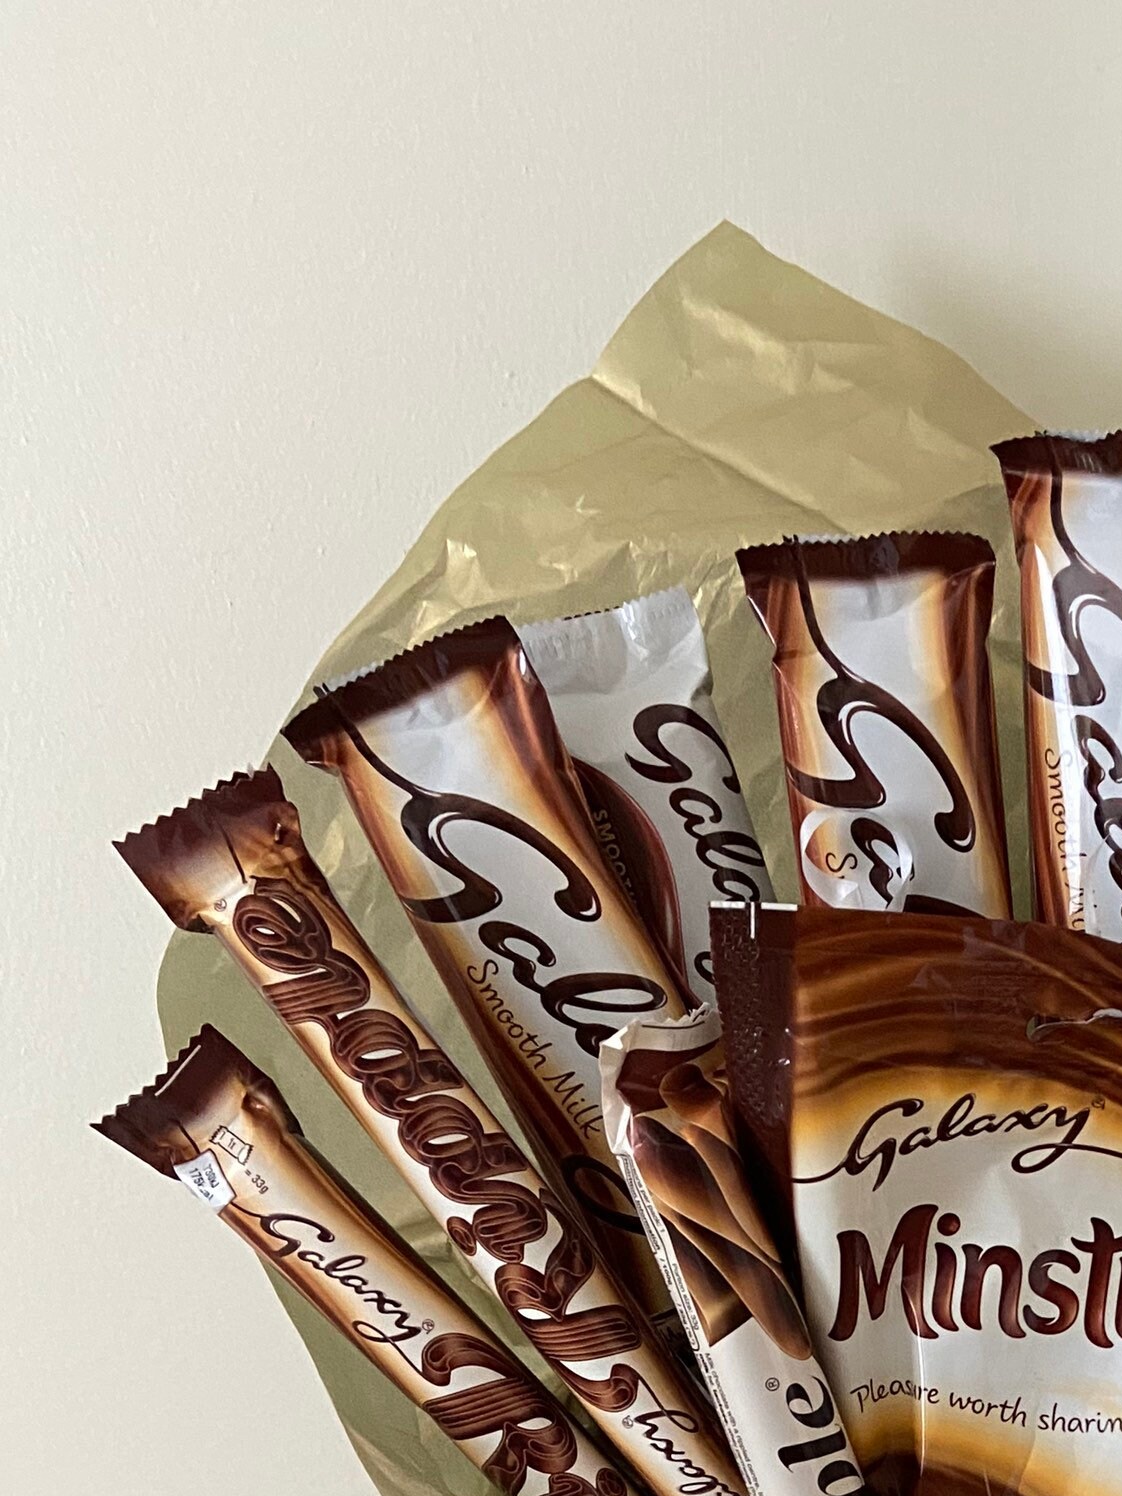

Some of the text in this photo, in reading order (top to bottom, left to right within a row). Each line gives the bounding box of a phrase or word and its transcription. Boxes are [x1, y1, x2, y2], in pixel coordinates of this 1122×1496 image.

[467, 959, 603, 1140] Smooth Milk
[233, 876, 641, 1412] Ripple
[251, 1174, 269, 1195] 33g
[838, 1093, 1092, 1192] Galaxy
[257, 1213, 422, 1343] Galaxy
[949, 1391, 1027, 1428] worth
